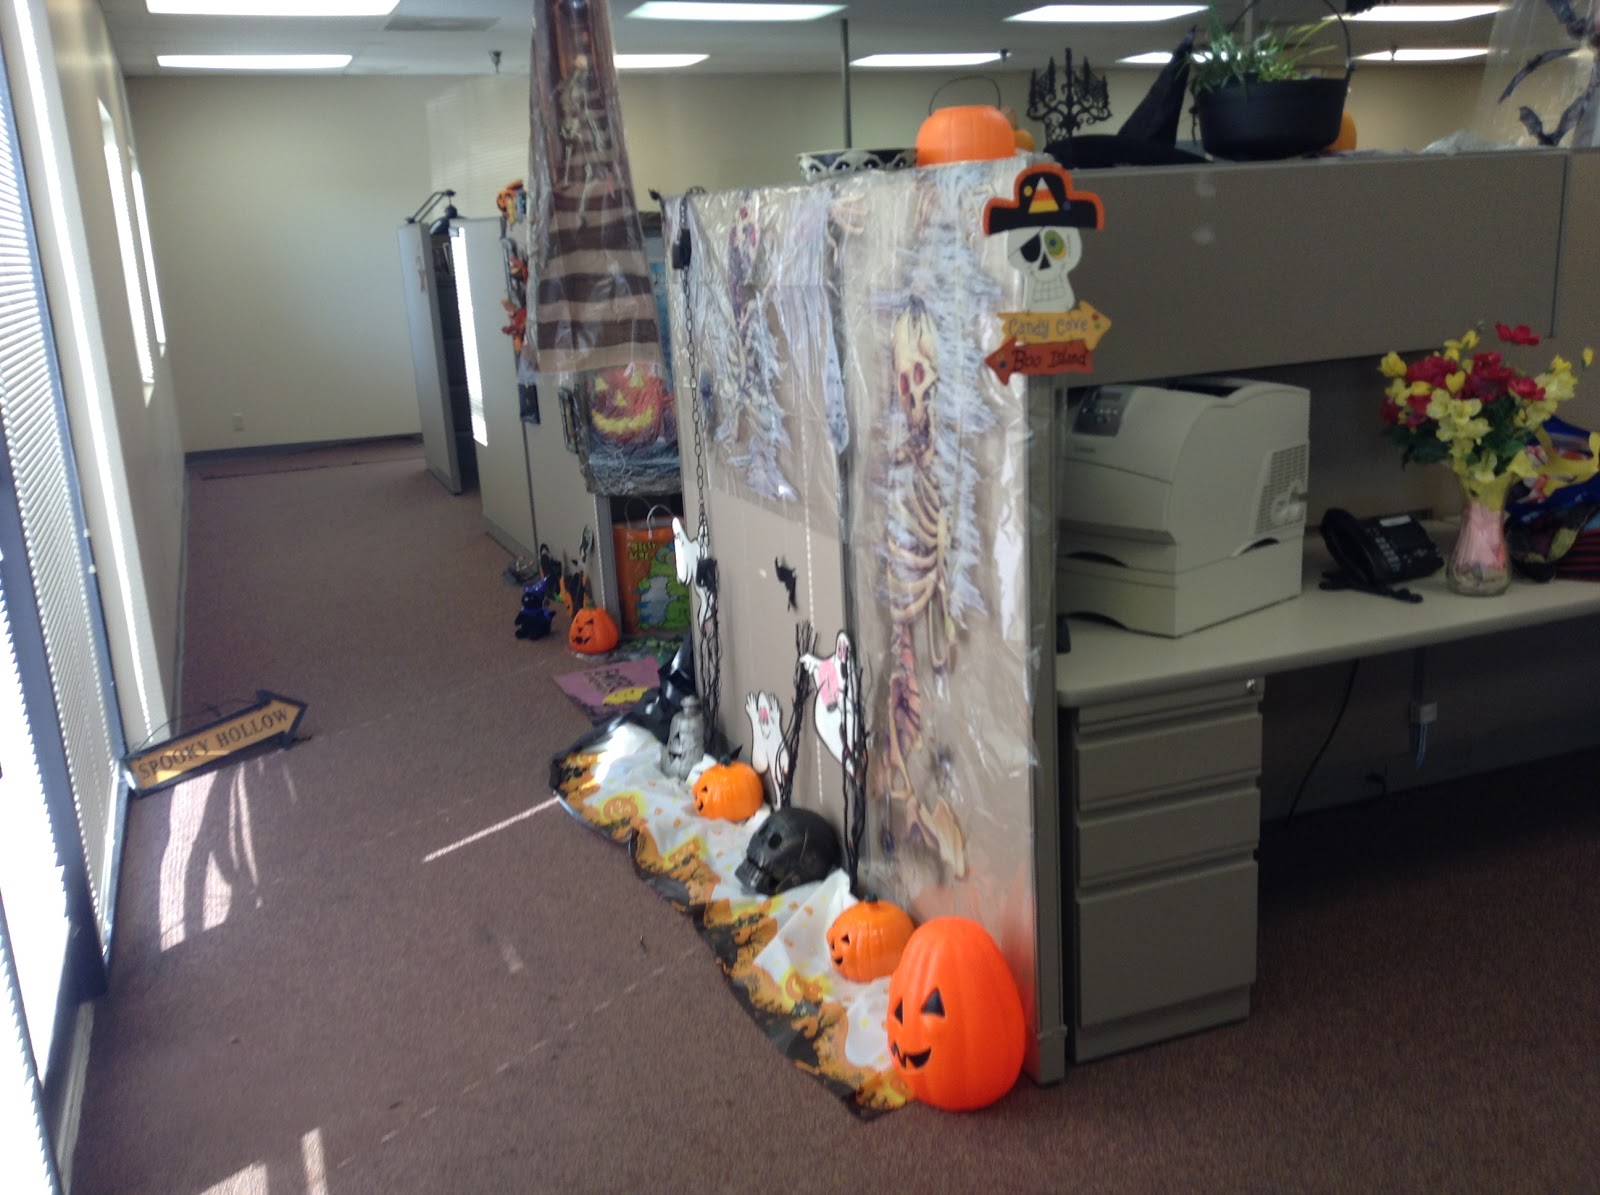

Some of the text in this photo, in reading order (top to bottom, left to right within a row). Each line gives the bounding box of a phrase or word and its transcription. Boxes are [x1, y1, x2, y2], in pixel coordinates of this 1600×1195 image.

[1013, 350, 1041, 371] Boo
[139, 708, 288, 778] SPOOKY HOLLOW
